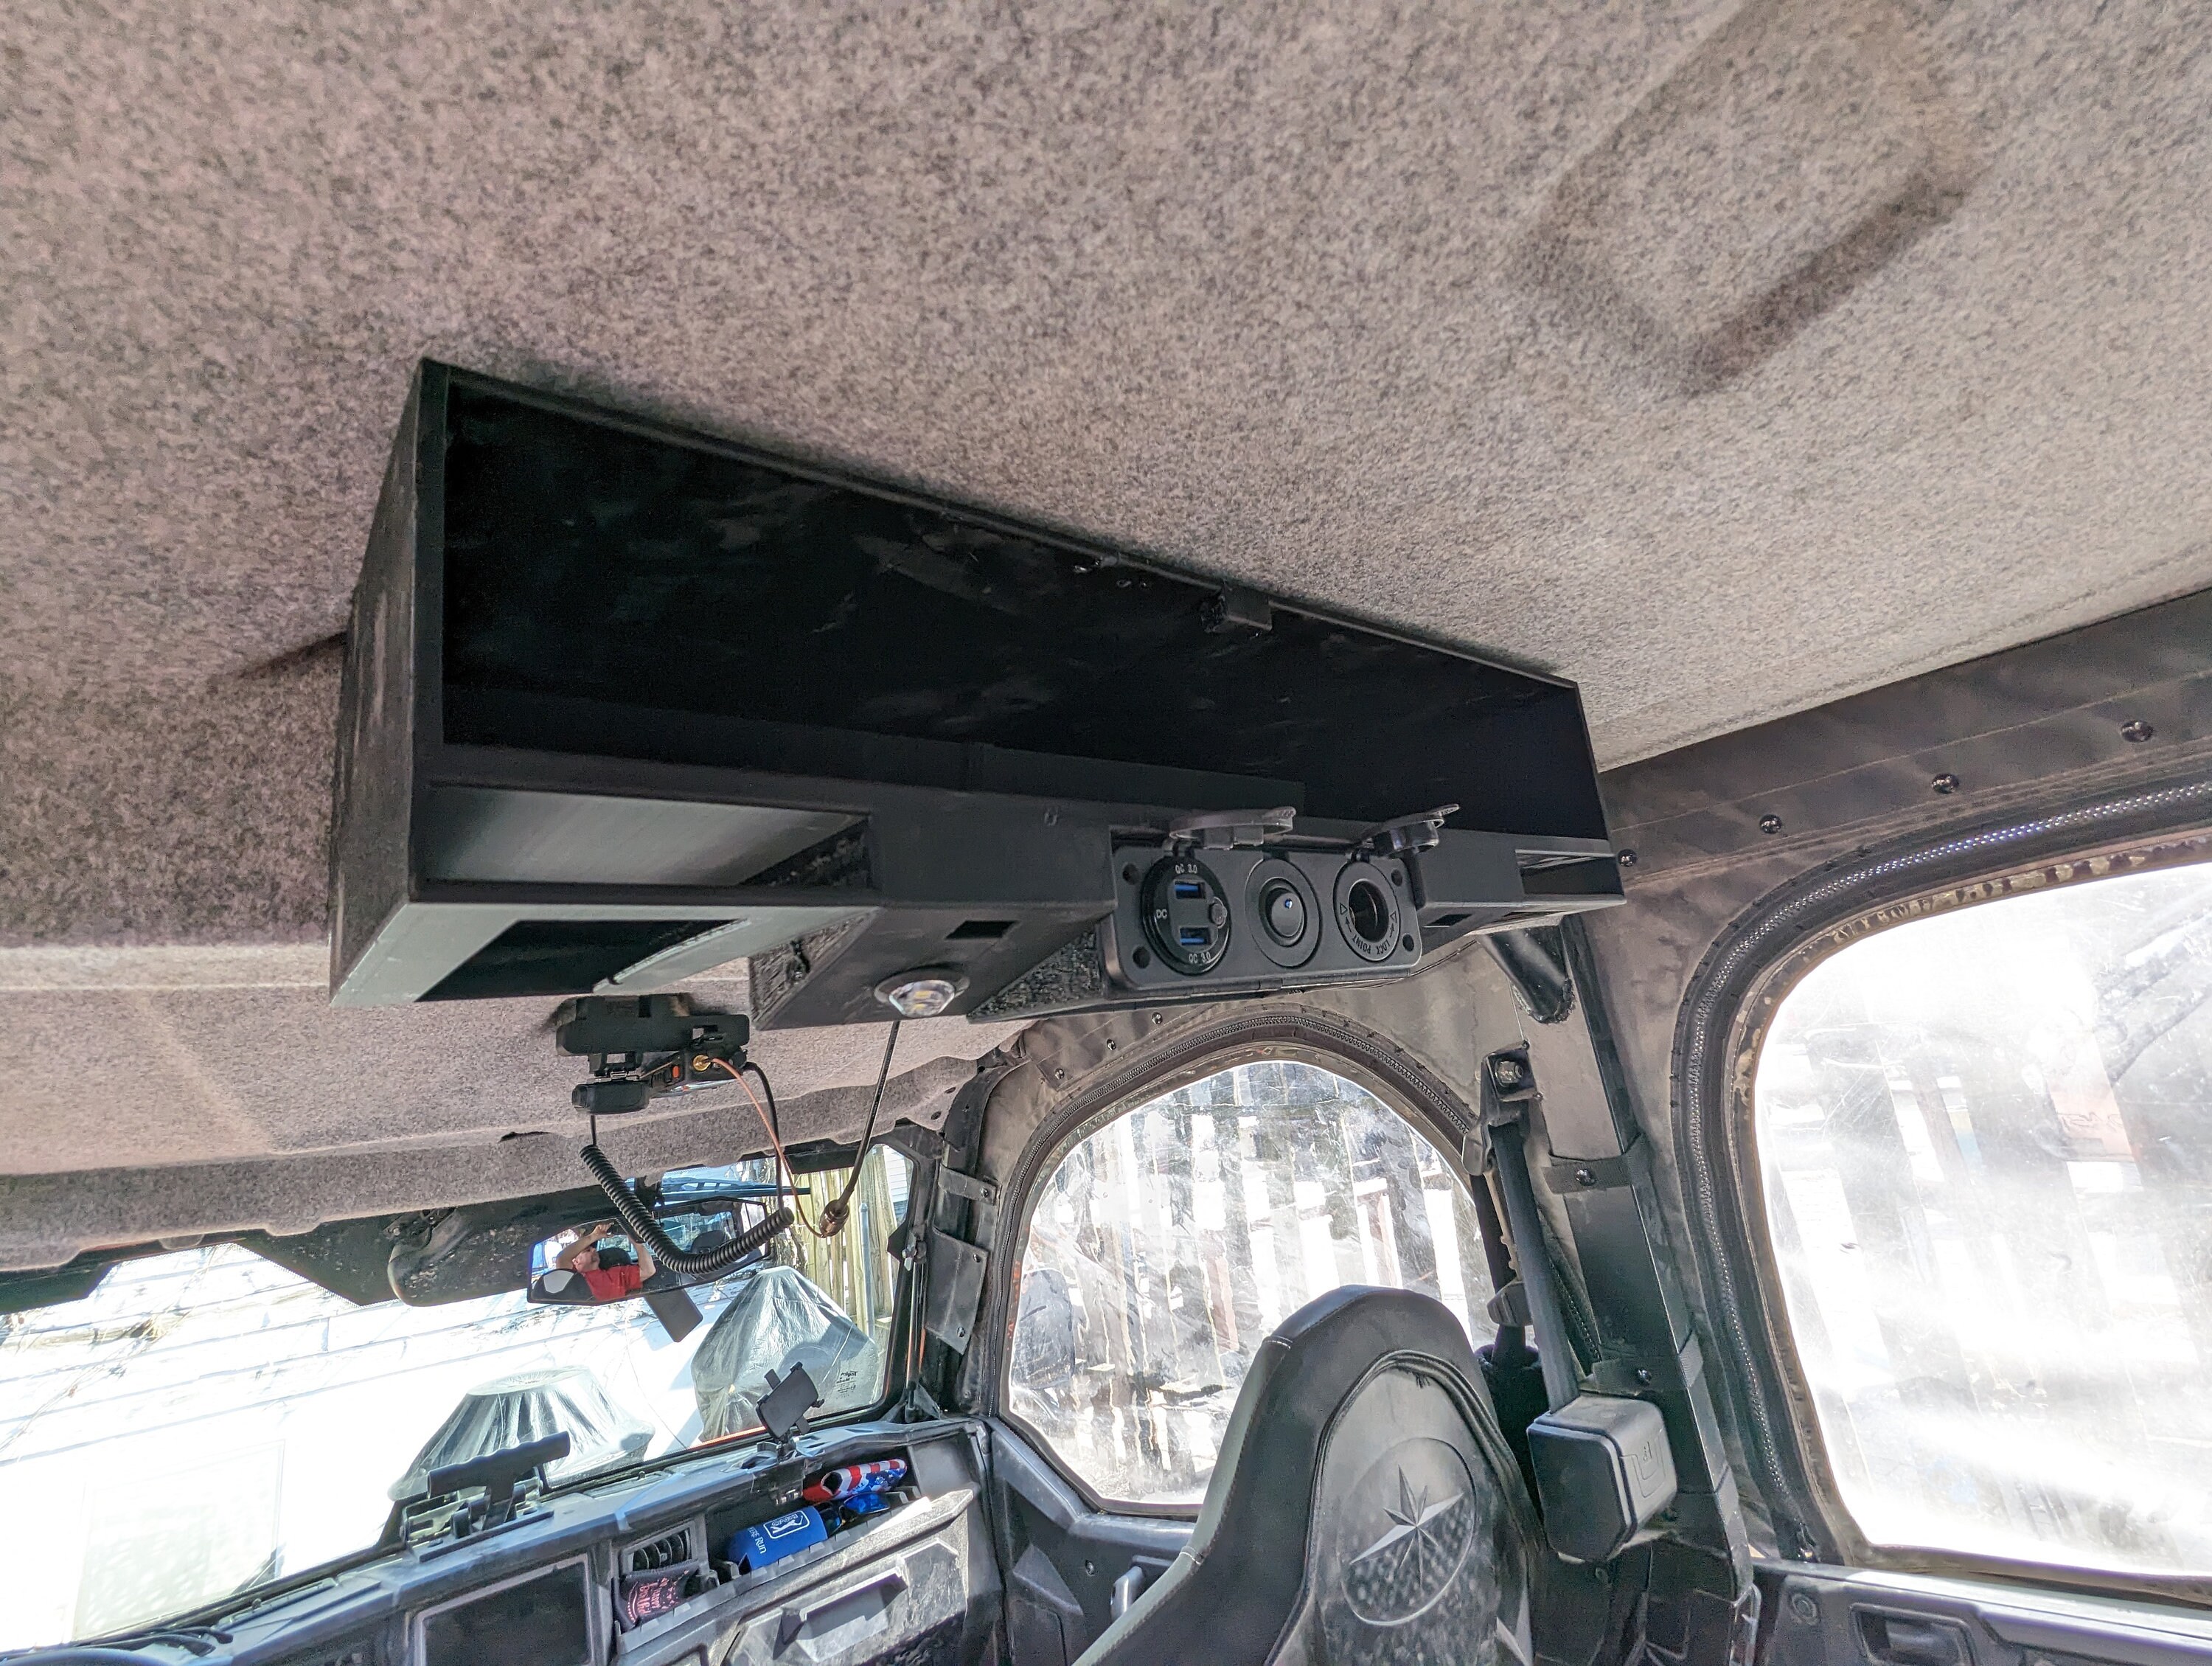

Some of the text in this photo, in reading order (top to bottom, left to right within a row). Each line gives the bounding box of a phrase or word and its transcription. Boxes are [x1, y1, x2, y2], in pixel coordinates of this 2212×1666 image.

[1156, 909, 1167, 919] DC
[1352, 934, 1390, 954] LOCK POINT
[755, 1534, 767, 1554] Run
